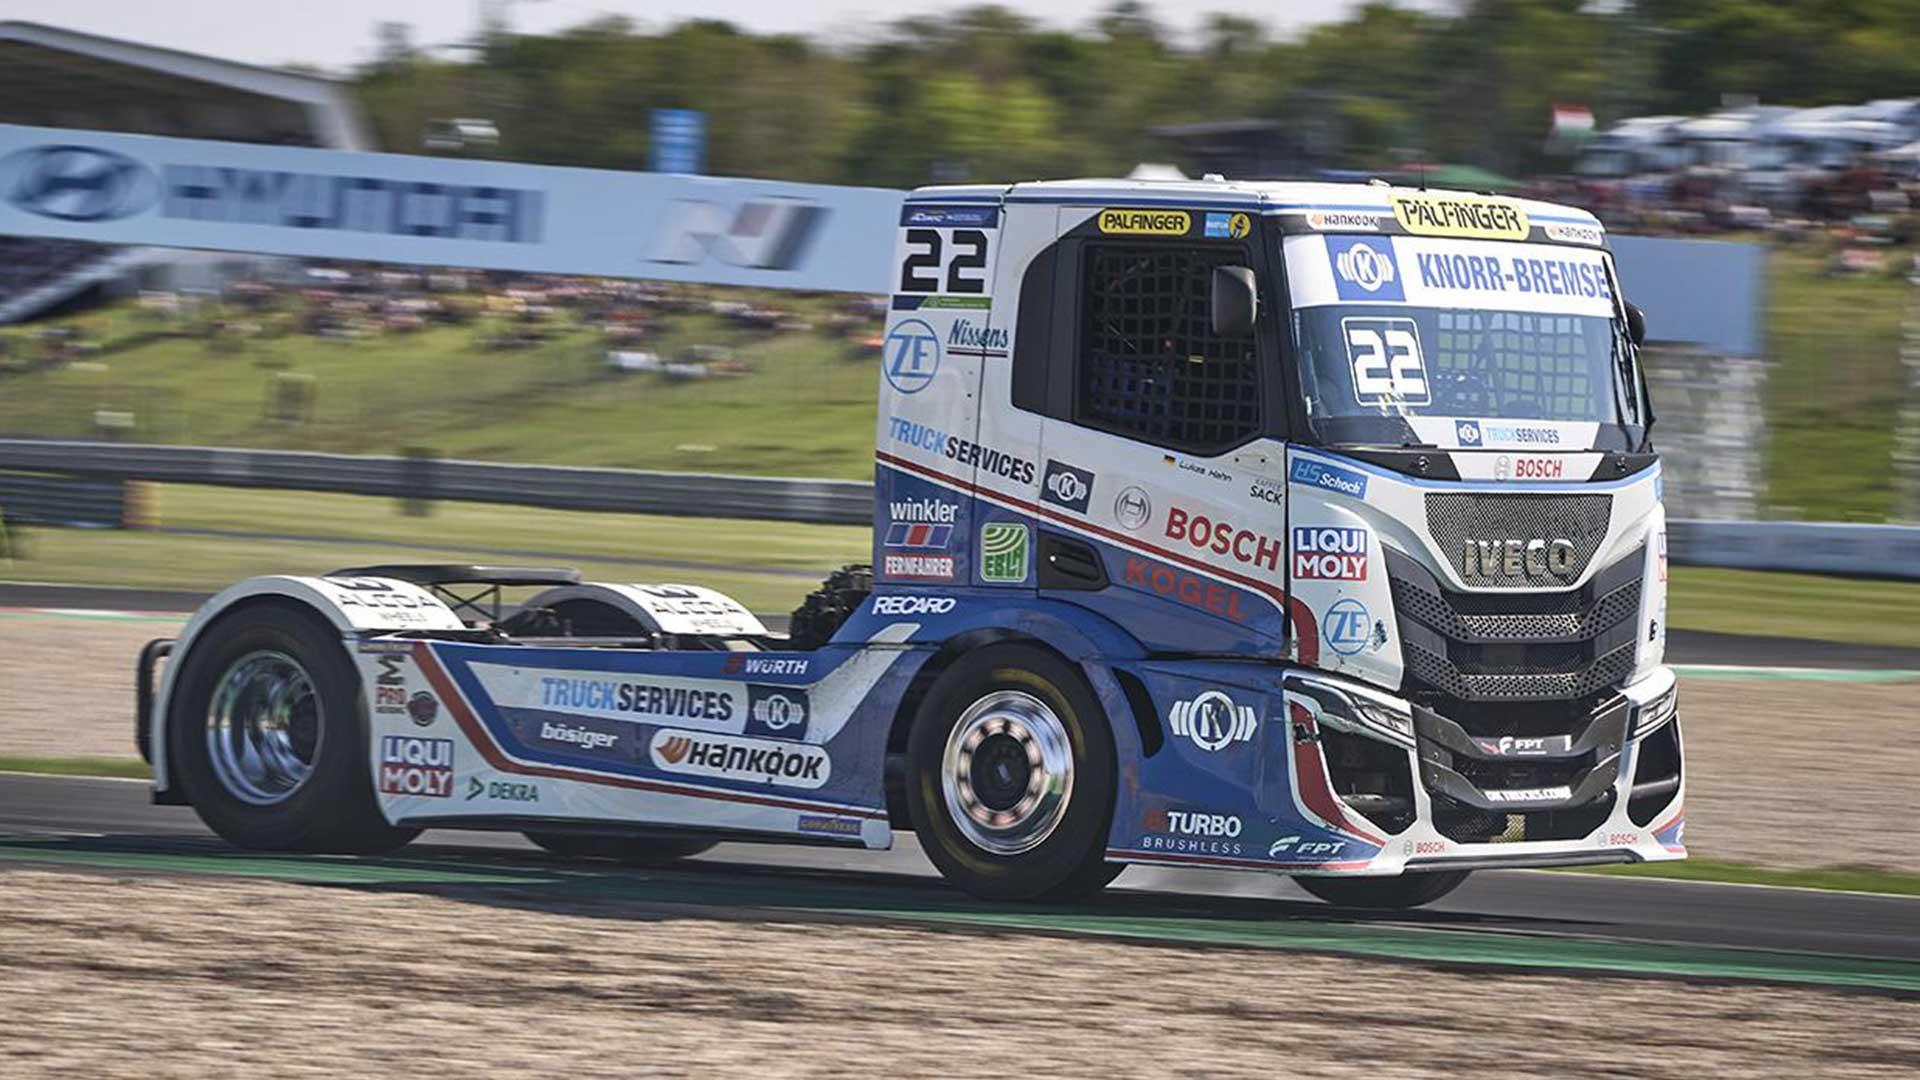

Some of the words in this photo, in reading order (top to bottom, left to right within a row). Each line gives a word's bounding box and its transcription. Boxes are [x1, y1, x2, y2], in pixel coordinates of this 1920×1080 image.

[1104, 212, 1185, 231] PALFINGER
[1397, 198, 1522, 232] PALFINGER
[901, 228, 988, 294] 22
[1416, 252, 1612, 300] KNORR-BREMSE
[948, 317, 1009, 349] Nissens
[889, 335, 938, 378] ZF
[1348, 328, 1429, 397] 22
[889, 416, 1036, 486] TRUCKSERVICES
[1514, 458, 1563, 478] BOSCH
[1250, 485, 1283, 505] SACK
[890, 497, 959, 523] winkler
[1164, 506, 1282, 572] BOSCH
[1295, 528, 1366, 556] LIQUI
[1295, 556, 1367, 580] MOLY
[1463, 538, 1577, 579] IVECO
[872, 597, 957, 615] RECARO
[1327, 611, 1369, 644] ZF
[745, 658, 809, 675] WÜRTH
[541, 676, 734, 722] TRUCKSERVICES
[539, 721, 620, 751] bösiger
[1514, 738, 1546, 750] FPT
[383, 737, 452, 765] LIQUI
[381, 766, 452, 796] MOLY
[488, 780, 541, 802] DEKRA
[1167, 811, 1243, 838] TURBO
[1143, 836, 1241, 856] BRUSHLESS
[1296, 841, 1347, 855] FPT
[1415, 841, 1446, 854] BOSCH
[1609, 832, 1639, 846] BOSCH
